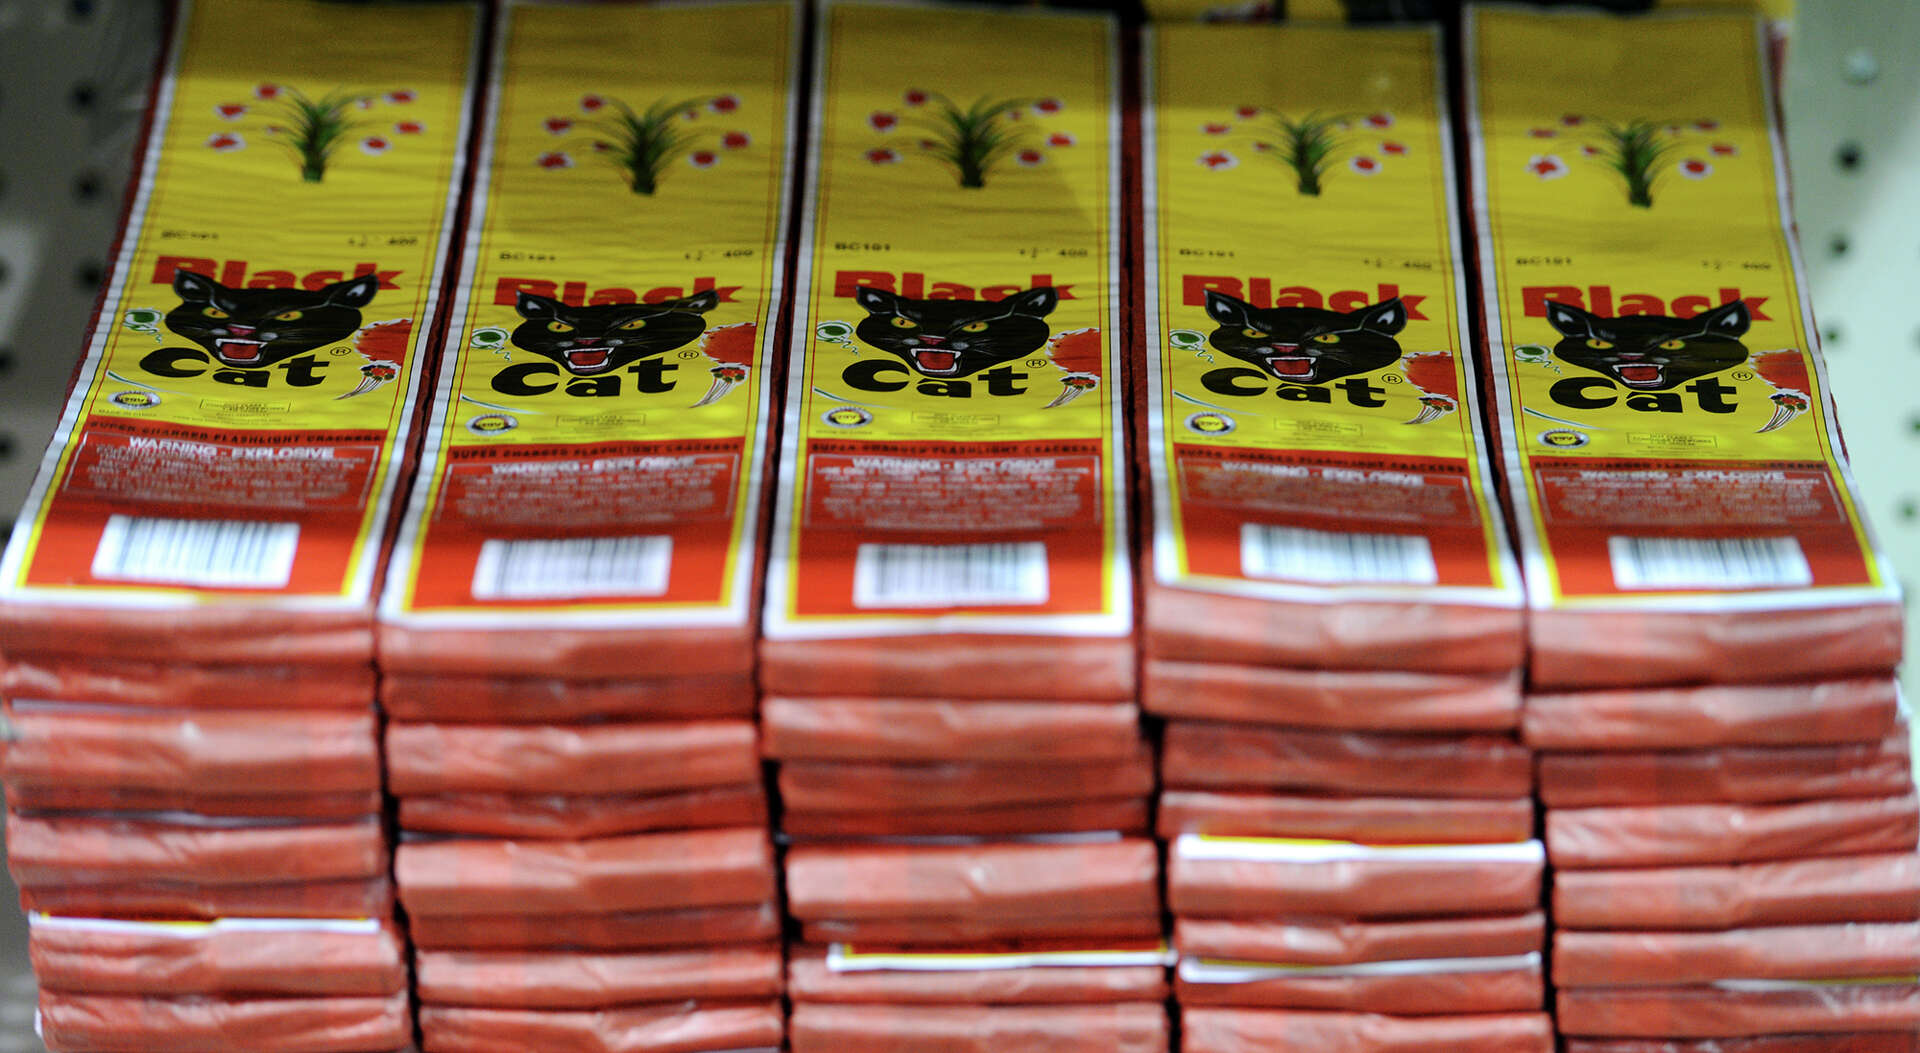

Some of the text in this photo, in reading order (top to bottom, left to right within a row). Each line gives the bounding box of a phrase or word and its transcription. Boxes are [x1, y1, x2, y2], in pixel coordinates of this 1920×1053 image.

[152, 256, 404, 291] Black
[494, 277, 743, 307] Black
[834, 270, 1079, 302] Black
[1183, 274, 1430, 321] Black
[1521, 285, 1774, 322] Black
[139, 347, 330, 388] Cat
[491, 357, 679, 398] Cat
[842, 359, 1029, 398] Cat
[1200, 367, 1386, 408] Cat
[1549, 376, 1739, 414] Cat
[129, 436, 218, 456] WARNING
[231, 447, 335, 459] EXPLOSIVE
[213, 434, 300, 444] FLASHLIGHT
[452, 448, 496, 459] SUPER
